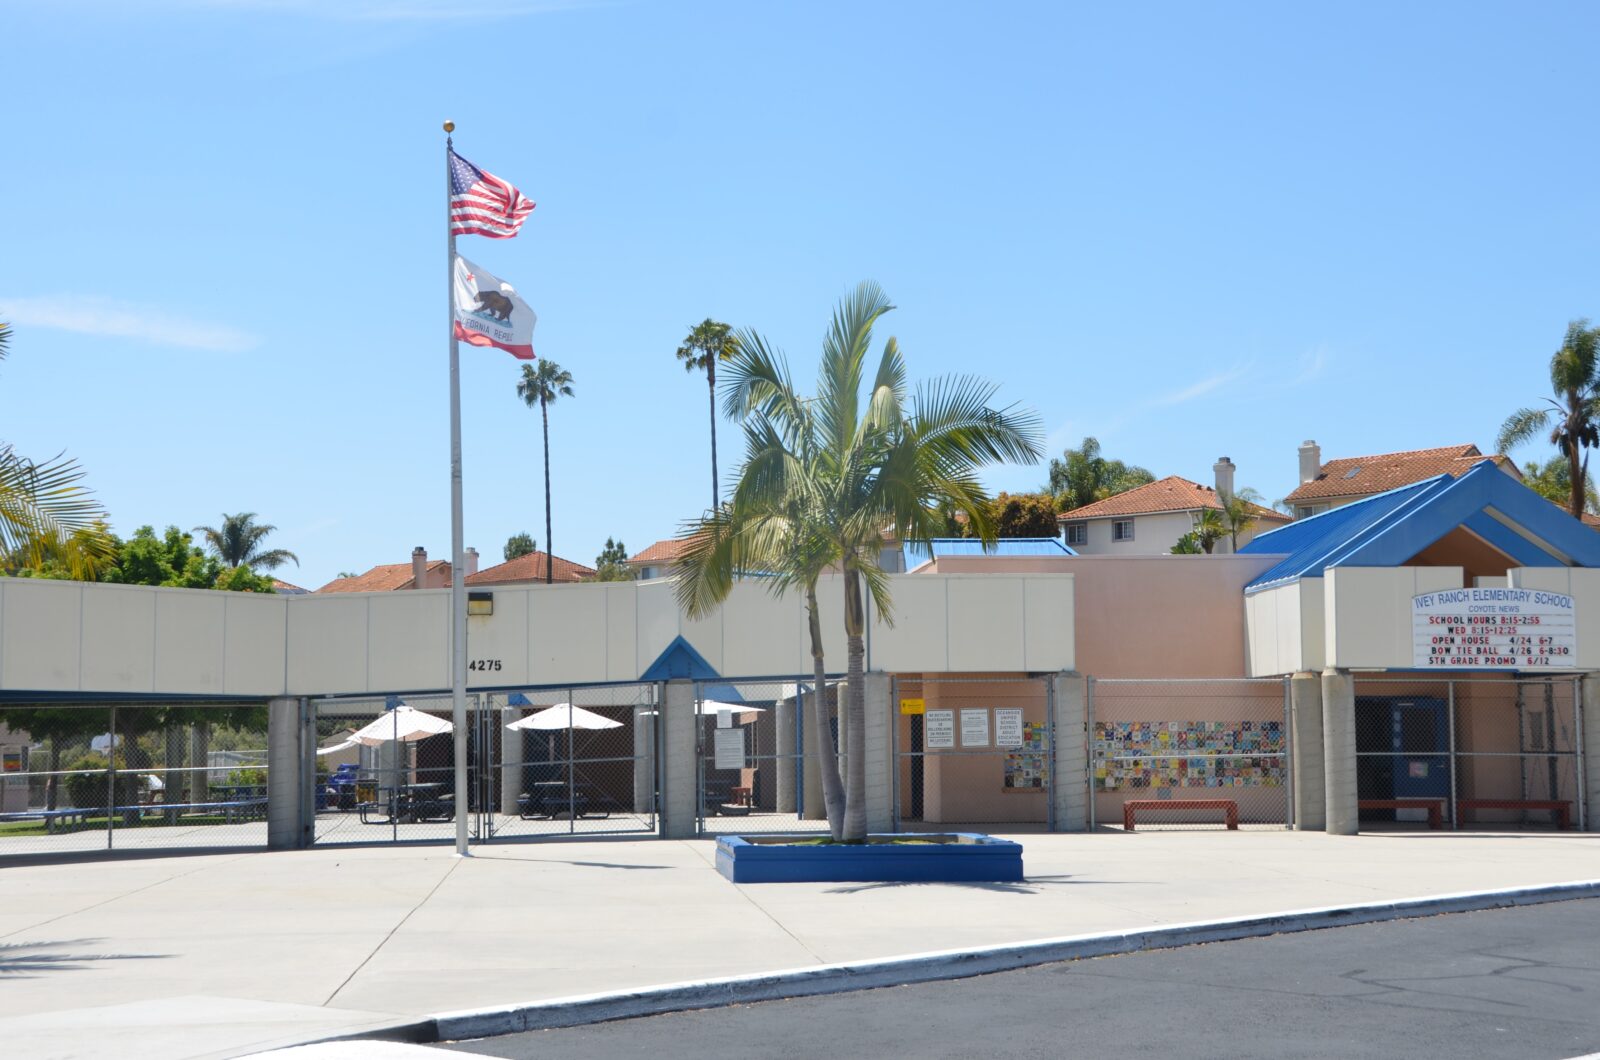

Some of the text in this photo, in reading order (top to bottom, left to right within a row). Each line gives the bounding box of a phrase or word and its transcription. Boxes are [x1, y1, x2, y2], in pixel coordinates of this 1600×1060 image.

[1415, 589, 1572, 609] IVEY RANCH ELEMENTARY SCHOOL
[1468, 605, 1520, 613] COYOTE NEWS
[1429, 616, 1540, 624] SCHOOL HOURS 8:15-2:55
[1447, 626, 1466, 635] WED
[1432, 636, 1553, 645] OPEN HOUSE 4/24 6-7
[1431, 646, 1569, 655] BOW TIE BALL 4/26 6-8:30
[1429, 656, 1550, 665] 5TH GRADE PROMO 6/12
[469, 660, 502, 671] 4275
